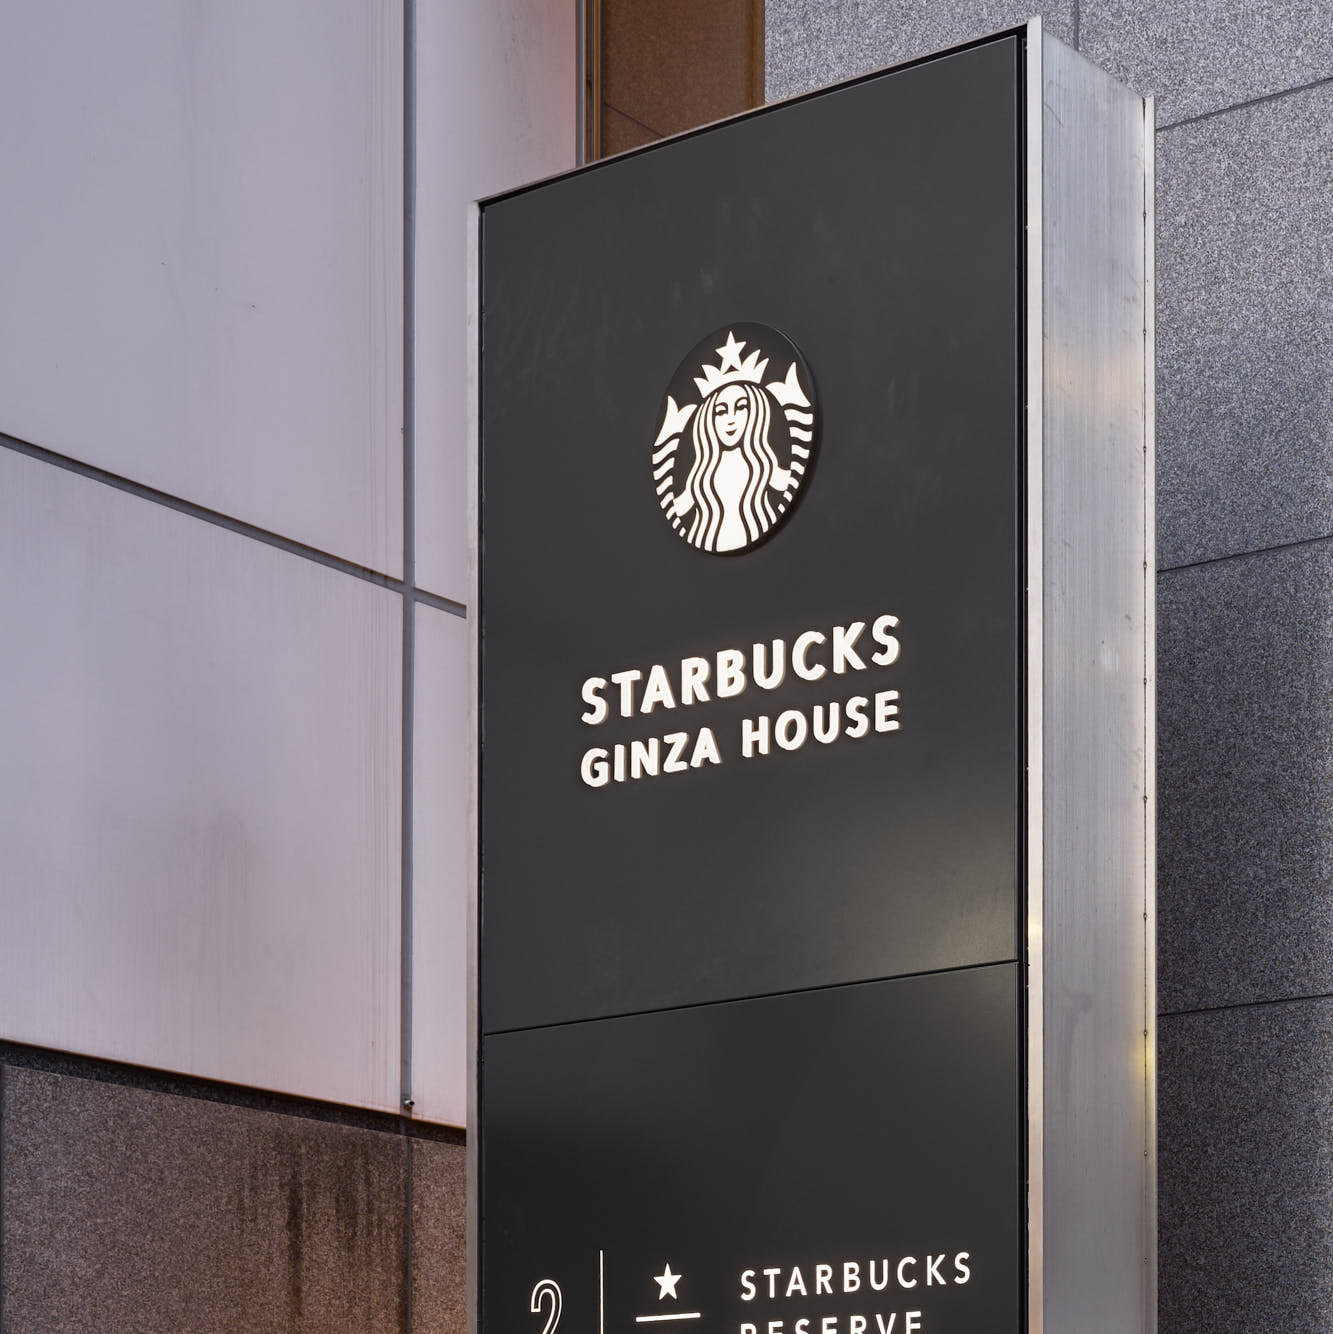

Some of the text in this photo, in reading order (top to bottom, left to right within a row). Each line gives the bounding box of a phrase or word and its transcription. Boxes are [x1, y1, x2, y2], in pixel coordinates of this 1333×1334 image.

[581, 614, 900, 726] STARBUCKS
[580, 690, 900, 788] GINZA HOUSE
[740, 1251, 972, 1302] STARBUCKS
